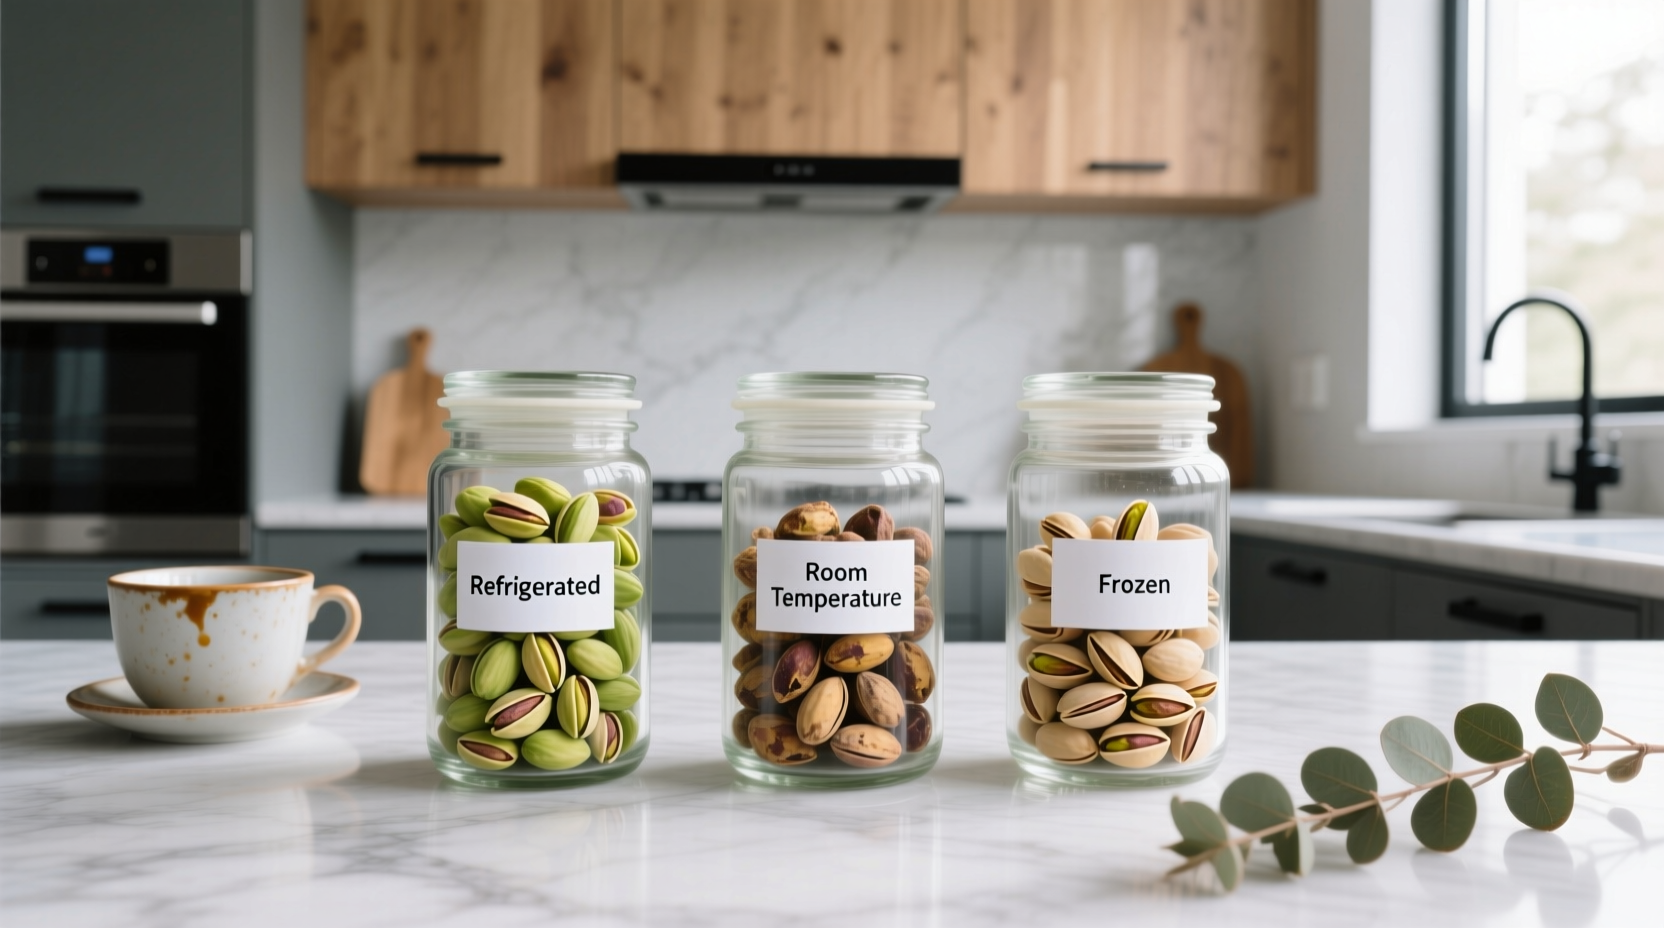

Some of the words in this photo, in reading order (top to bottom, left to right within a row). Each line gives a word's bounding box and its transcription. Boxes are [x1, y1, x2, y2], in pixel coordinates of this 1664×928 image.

[805, 561, 867, 582] Room
[1099, 573, 1170, 594] Frozen
[470, 573, 600, 602] Refrigerated
[770, 586, 902, 613] Temperature
